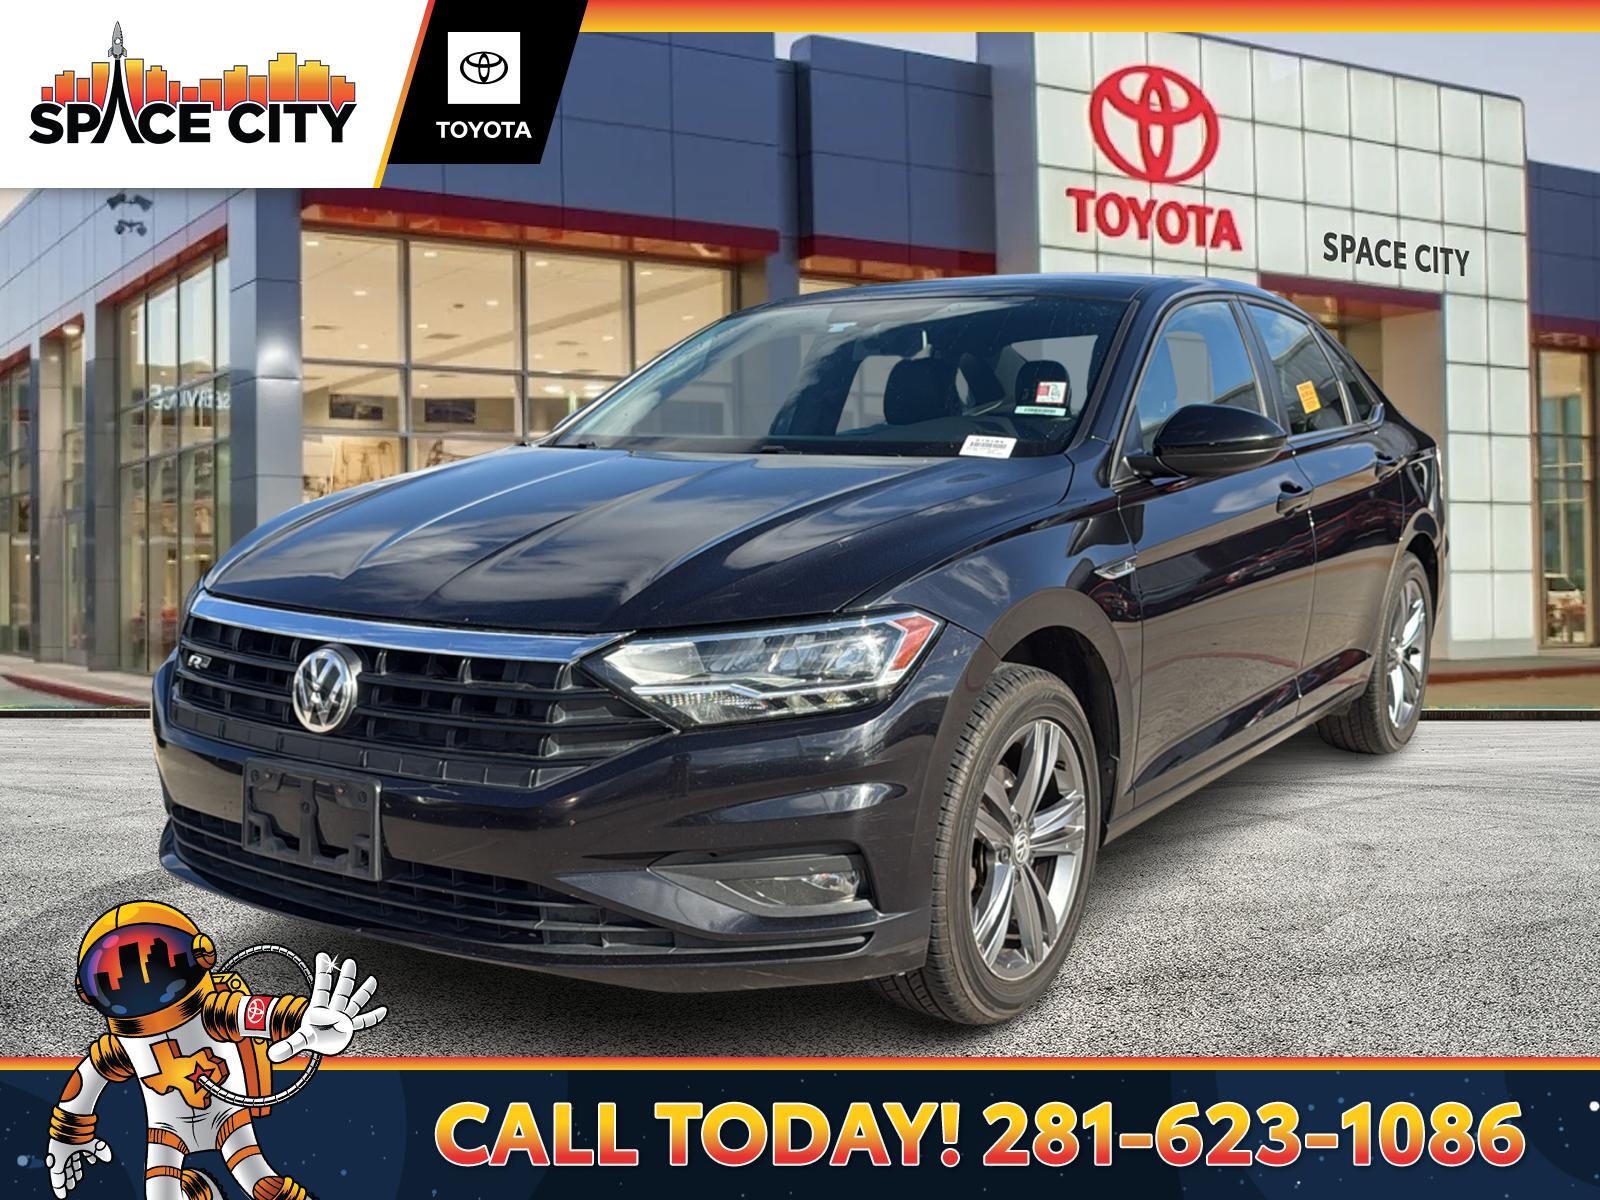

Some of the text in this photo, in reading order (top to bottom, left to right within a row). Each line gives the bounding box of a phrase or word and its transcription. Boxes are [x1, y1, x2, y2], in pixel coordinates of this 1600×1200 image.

[1066, 187, 1242, 251] TOYOTA
[1323, 232, 1470, 276] SPACE CITY
